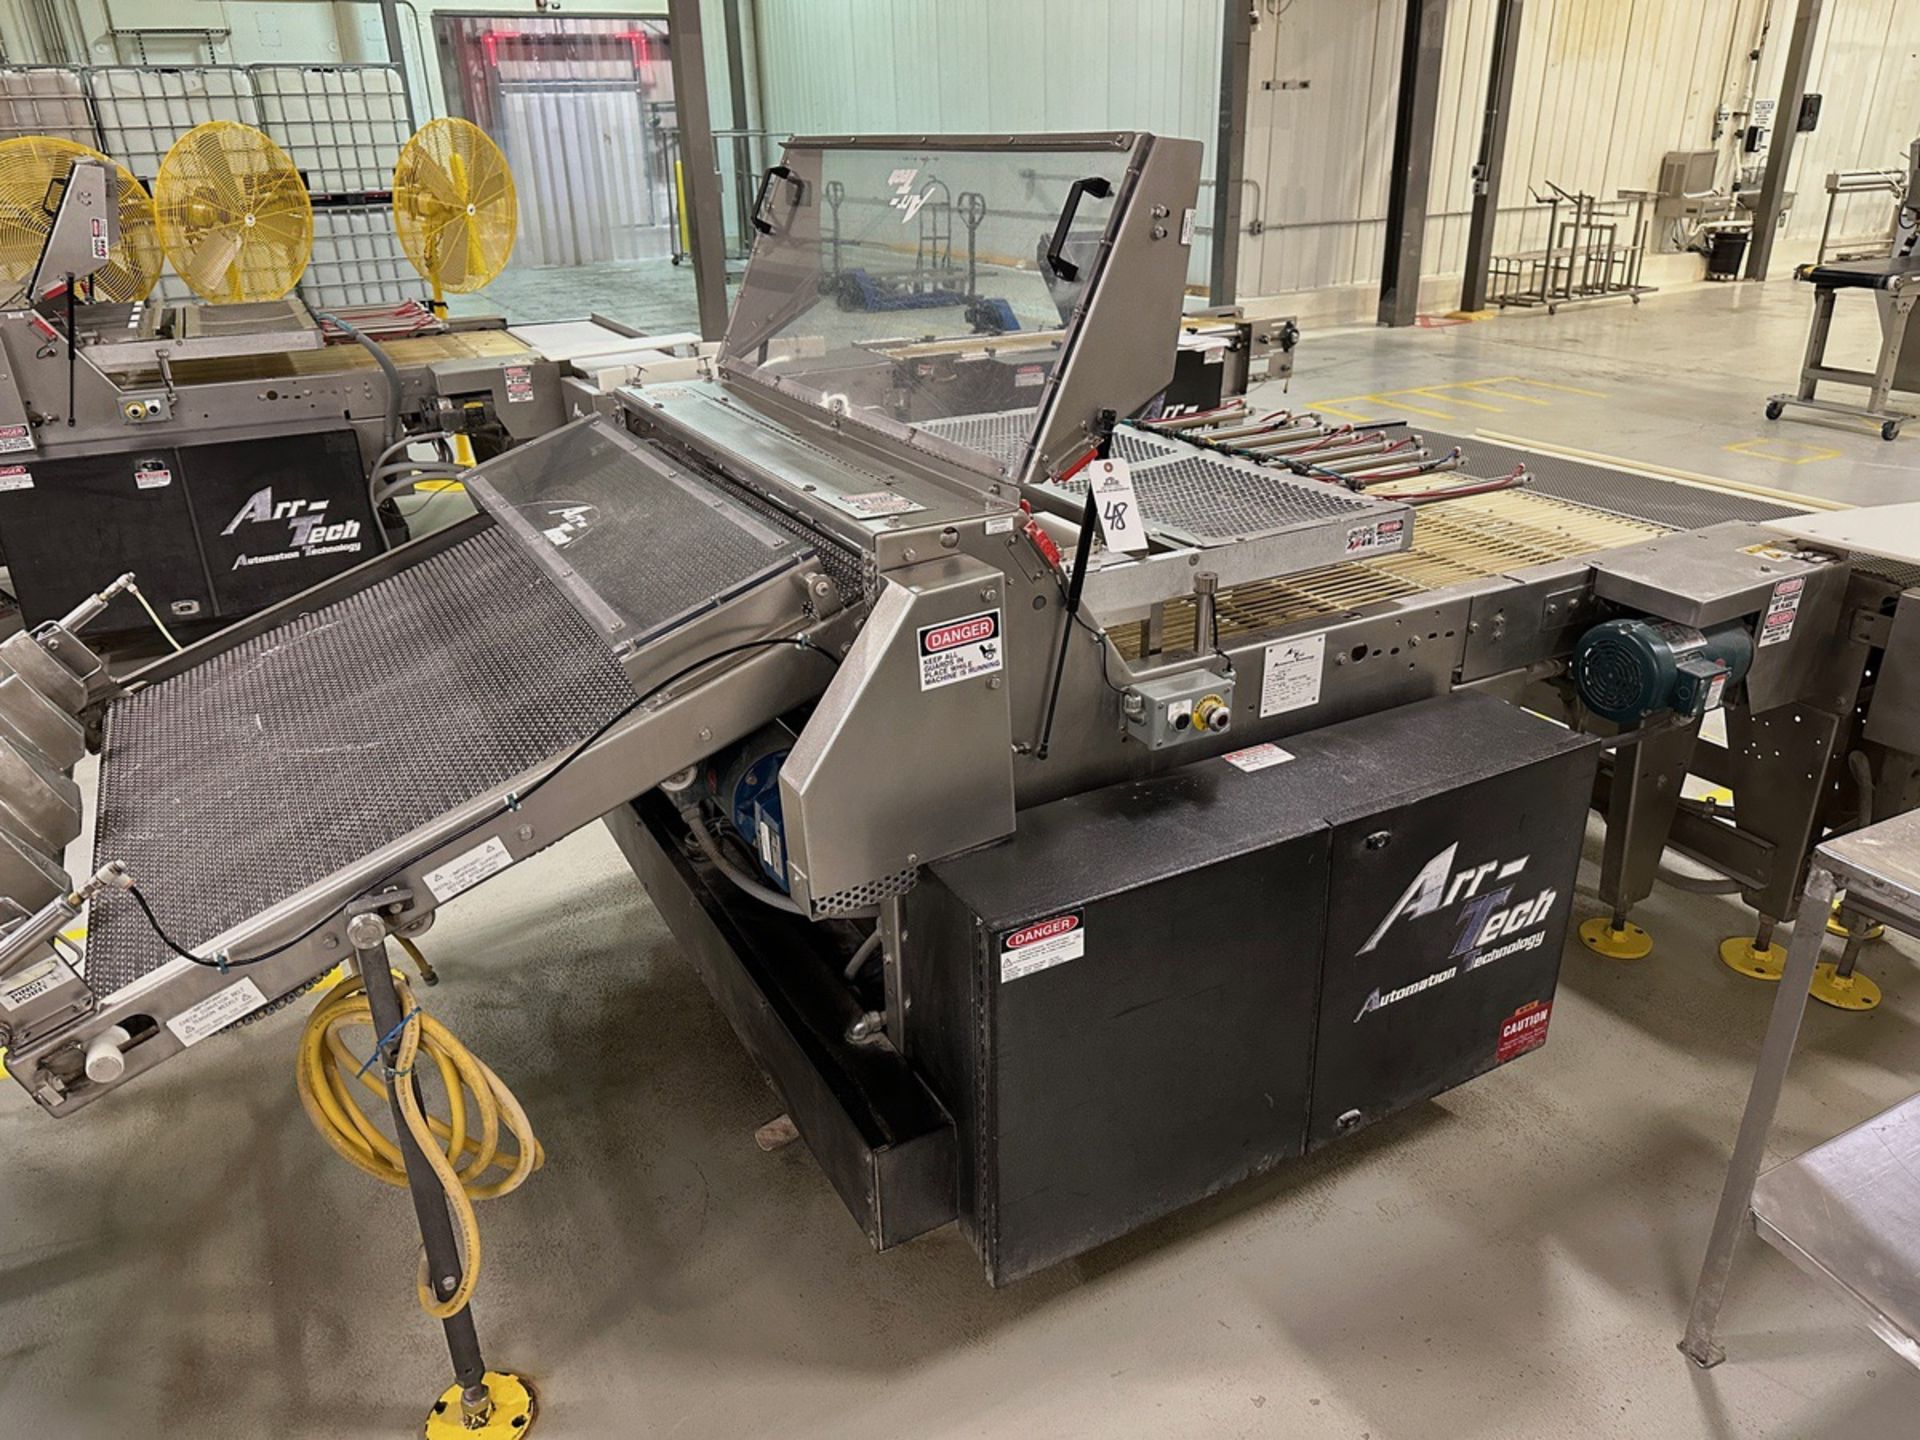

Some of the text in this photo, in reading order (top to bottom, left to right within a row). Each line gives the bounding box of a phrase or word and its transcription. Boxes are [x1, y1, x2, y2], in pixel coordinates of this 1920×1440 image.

[220, 486, 329, 536] Arr-
[1103, 501, 1128, 530] 48
[287, 513, 361, 547] Tech
[231, 541, 362, 571] Automation Technology
[931, 620, 990, 647] DANGER
[924, 651, 958, 665] KEEP ALL
[924, 659, 955, 673] GUARDS
[924, 661, 972, 679] PLACE WHILE
[925, 673, 957, 685] MACHINE
[968, 660, 1000, 674] RUNNING
[1355, 841, 1531, 956] Arr-
[1015, 919, 1070, 945] DANGER
[1448, 883, 1557, 959] Tech
[1353, 930, 1547, 1023] Automation Technology
[1503, 1009, 1548, 1038] CAUTION
